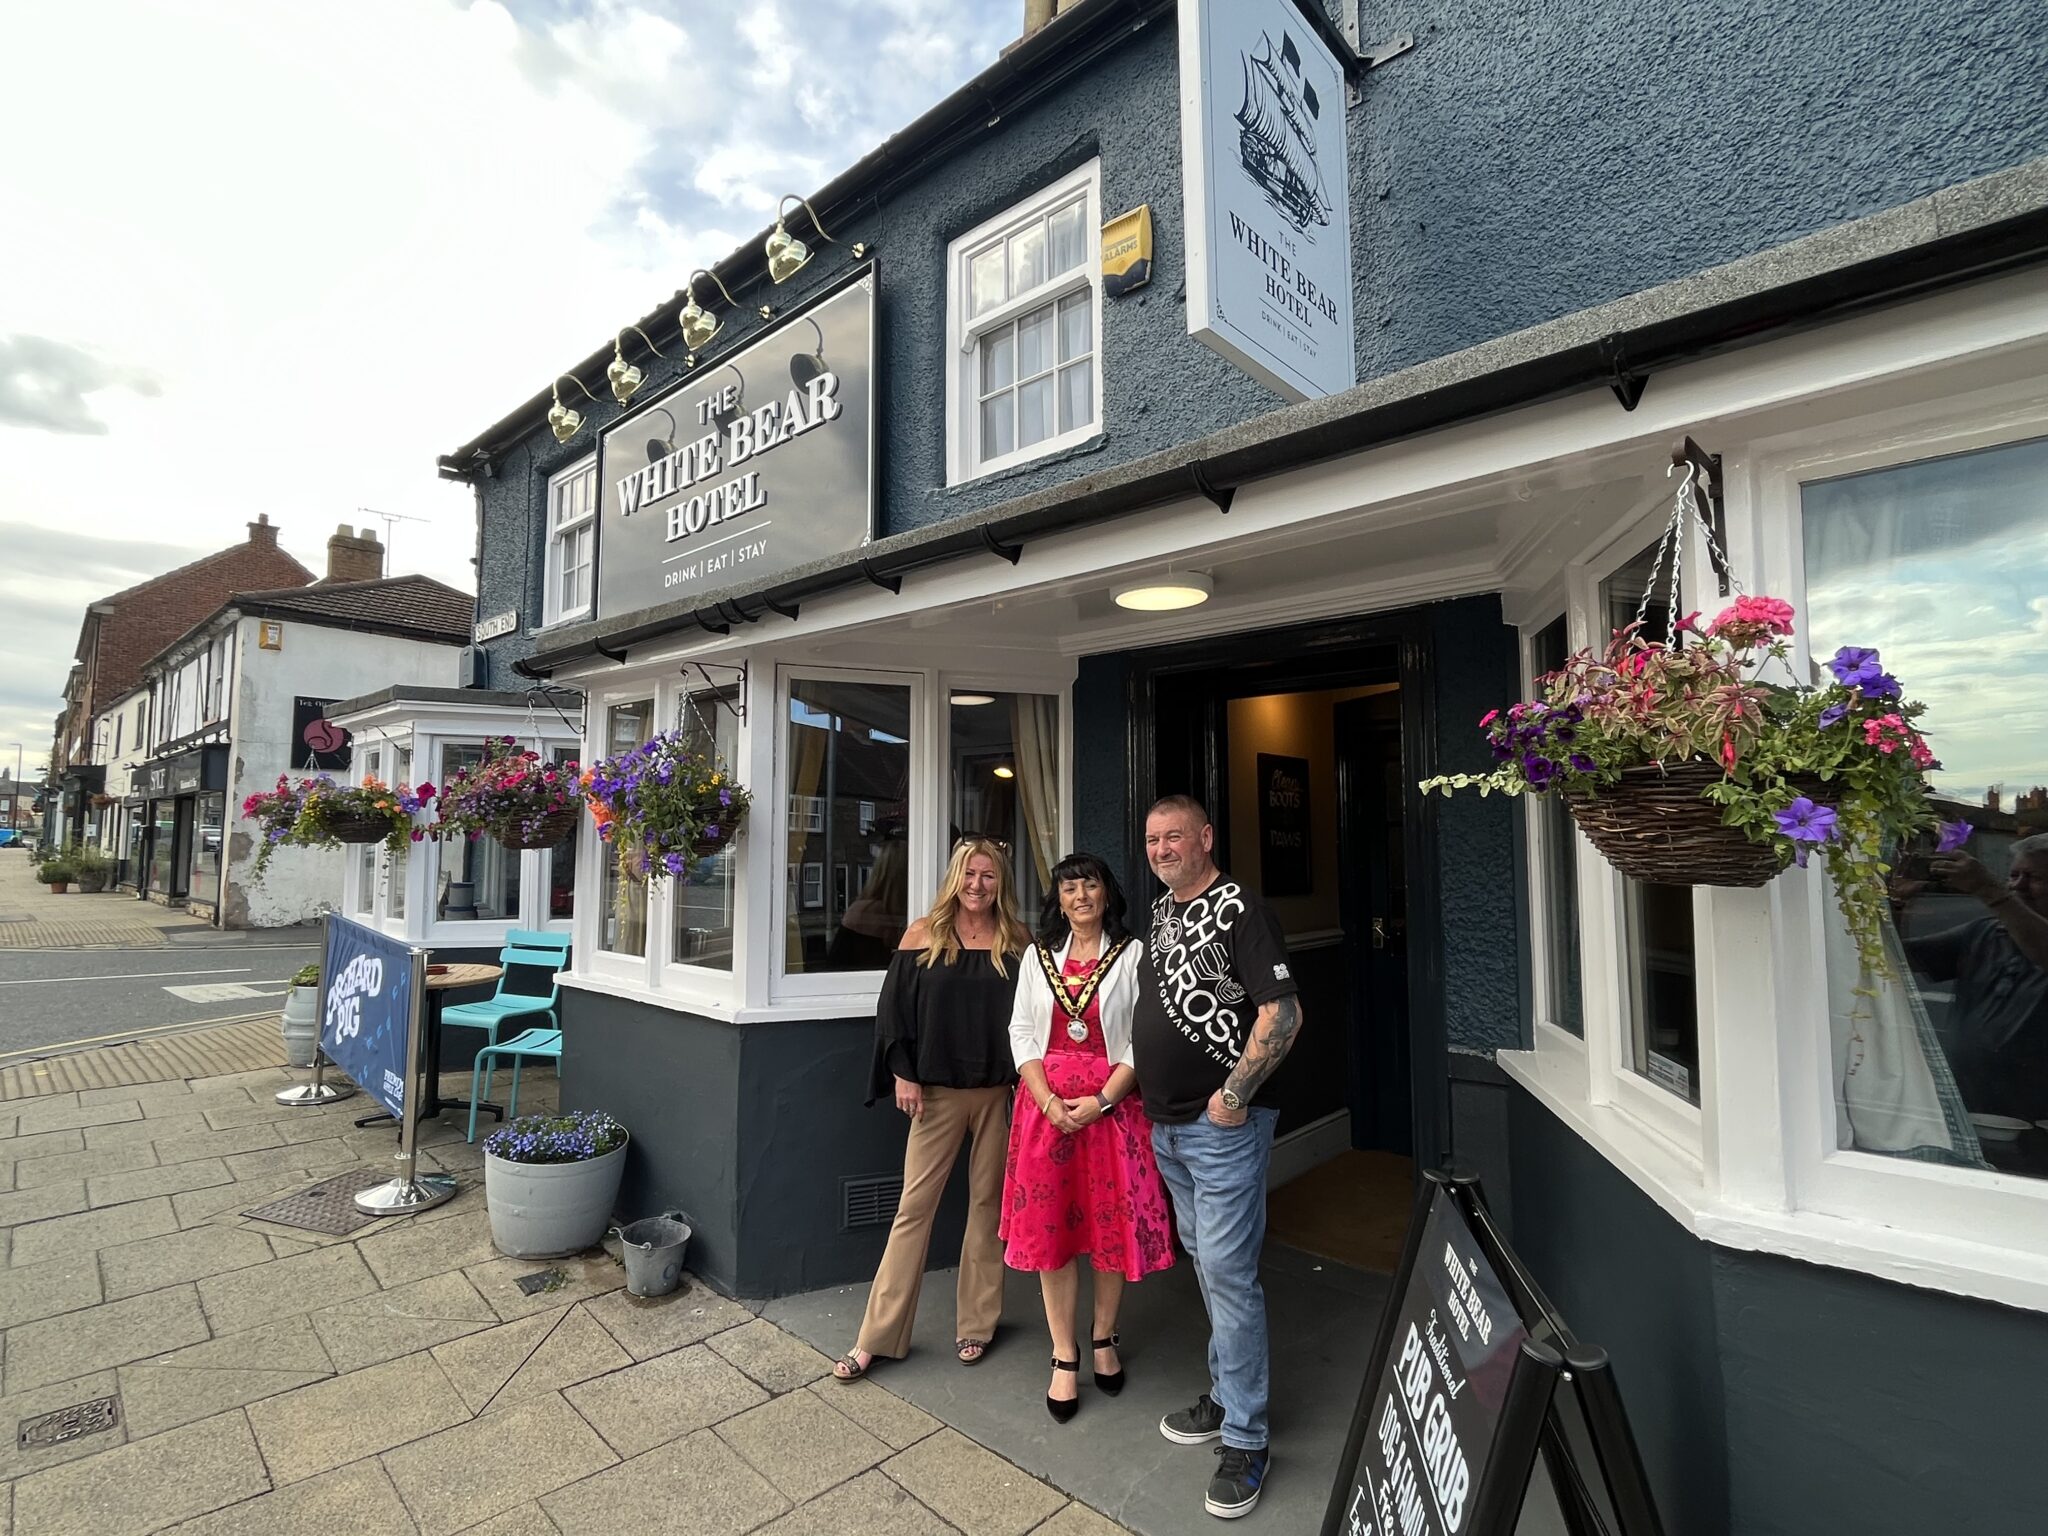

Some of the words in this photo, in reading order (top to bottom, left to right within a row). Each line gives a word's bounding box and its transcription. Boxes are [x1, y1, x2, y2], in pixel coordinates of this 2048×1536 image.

[1104, 240, 1138, 263] ALARMS
[1229, 210, 1291, 284] WHITE
[1296, 268, 1338, 325] BEAR
[1279, 231, 1297, 257] THE
[1265, 273, 1312, 328] HOTEL
[1261, 310, 1282, 333] DRINK
[1287, 330, 1298, 345] EAT
[1303, 343, 1317, 358] STAY
[696, 385, 737, 425] THE
[616, 432, 722, 516] WHITE
[727, 372, 842, 467] BEAR
[665, 471, 767, 542] HOTEL
[664, 565, 697, 588] DRINK
[707, 553, 728, 574] EAT
[738, 540, 768, 562] STAY
[501, 614, 515, 631] END
[326, 954, 383, 1026] ORCHARD
[1159, 980, 1200, 1043] FORWARD
[335, 996, 360, 1046] PIG
[1444, 1241, 1471, 1300] WHITE
[1466, 1286, 1492, 1346] BEAR
[1447, 1288, 1471, 1342] HOTEL
[1425, 1308, 1466, 1400] Traditional
[1399, 1321, 1432, 1420] PUB
[1423, 1393, 1470, 1534] GRUB
